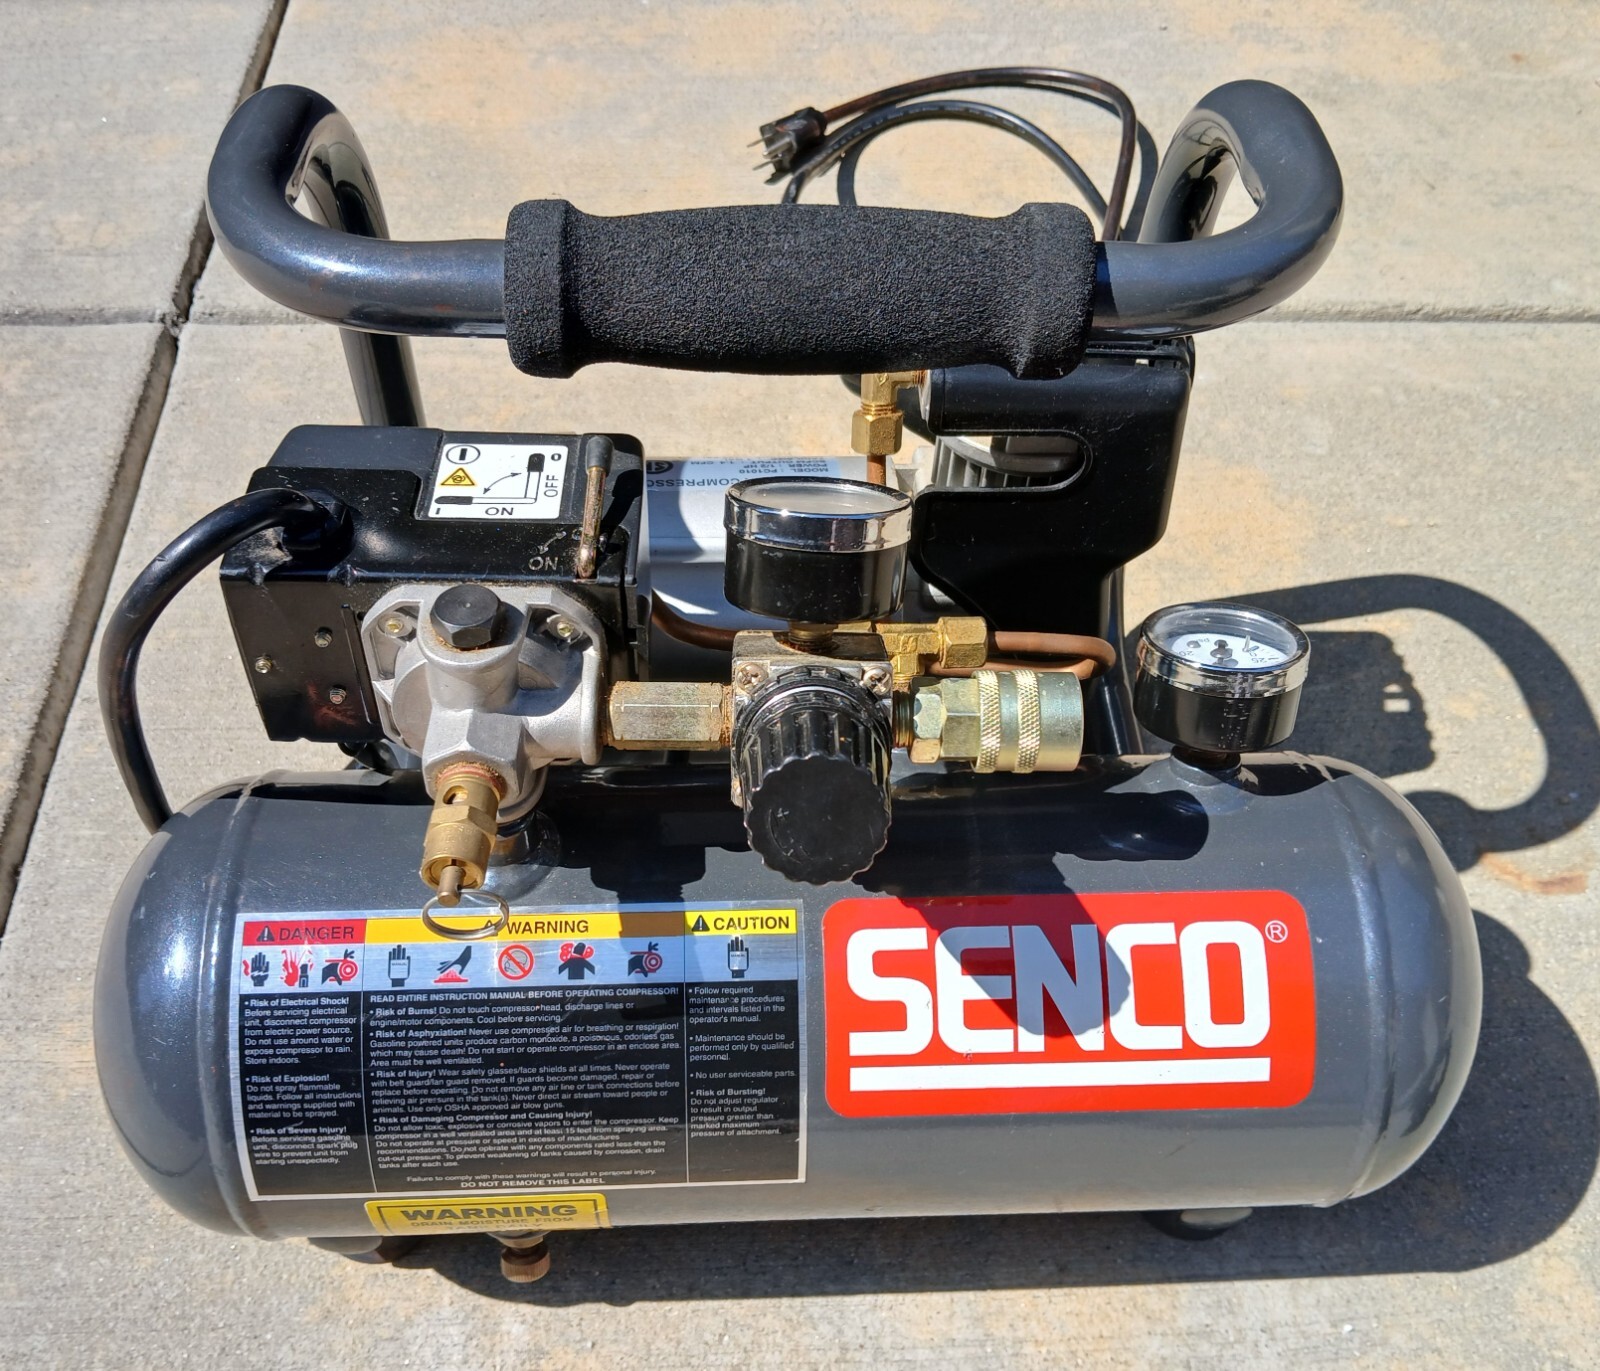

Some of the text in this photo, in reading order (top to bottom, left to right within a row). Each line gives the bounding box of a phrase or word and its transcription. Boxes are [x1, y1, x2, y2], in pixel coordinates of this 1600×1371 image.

[544, 474, 559, 497] OFF
[485, 507, 514, 516] ON
[528, 556, 558, 571] ON
[508, 920, 589, 934] WARNING
[714, 916, 790, 931] CAUTION
[280, 926, 354, 940] DANGER
[694, 985, 753, 995] Follow required
[846, 920, 1270, 1056] SENCO
[370, 986, 678, 1002] READ ENTIRE INSTRUCTION MANUAL BEFORE OPERATING COMPRESSOR!
[741, 994, 784, 1004] procedures
[250, 998, 268, 1006] Risk
[280, 997, 318, 1006] Electrical
[320, 996, 349, 1004] Shock!
[244, 1006, 347, 1016] Before servicing electrical
[375, 1007, 394, 1015] Risk
[396, 1006, 406, 1014] of
[408, 1006, 436, 1014] Burns!
[439, 1005, 450, 1013] Do
[467, 1004, 489, 1013] touch
[492, 1005, 539, 1013] compressor
[564, 1002, 603, 1011] discharge
[605, 1001, 623, 1009] lines
[689, 1003, 785, 1013] and intervals listed in the
[264, 1017, 307, 1025] disconnect
[309, 1017, 356, 1026] compressor
[477, 1014, 495, 1023] Cool
[497, 1014, 523, 1022] before
[689, 1014, 728, 1025] operator's
[244, 1027, 262, 1035] from
[264, 1026, 294, 1035] electric
[296, 1027, 320, 1036] power
[375, 1029, 394, 1037] Risk
[396, 1029, 405, 1037] of
[408, 1027, 466, 1038] Asphyxiation!
[468, 1027, 492, 1035] Never
[511, 1024, 559, 1035] compressed
[561, 1024, 572, 1032] air
[574, 1024, 584, 1032] for
[586, 1023, 623, 1033] breathing
[244, 1037, 256, 1045] Do
[290, 1035, 318, 1044] around
[370, 1039, 405, 1047] Gasoline
[407, 1037, 442, 1048] powered
[444, 1037, 463, 1045] units
[465, 1036, 497, 1046] produce
[499, 1035, 527, 1044] carbon
[659, 1033, 674, 1041] gas
[695, 1033, 745, 1042] Maintenance
[747, 1032, 773, 1040] should
[244, 1048, 273, 1056] expose
[275, 1046, 322, 1055] compressor
[689, 1042, 729, 1053] performed
[731, 1042, 748, 1051] only
[750, 1042, 759, 1051] by
[425, 1056, 441, 1065] well
[251, 1074, 270, 1082] Risk
[283, 1073, 329, 1083] Explosion!
[728, 1069, 772, 1078] serviceable
[275, 1084, 296, 1093] spray
[696, 1088, 714, 1096] Risk
[727, 1086, 765, 1096] Bursting!
[411, 1114, 454, 1123] Damaging
[456, 1113, 507, 1122] Compressor
[528, 1111, 563, 1119] Causing
[565, 1110, 592, 1119] Injury!
[319, 1125, 346, 1134] Injury!
[400, 1204, 577, 1221] WARNING
